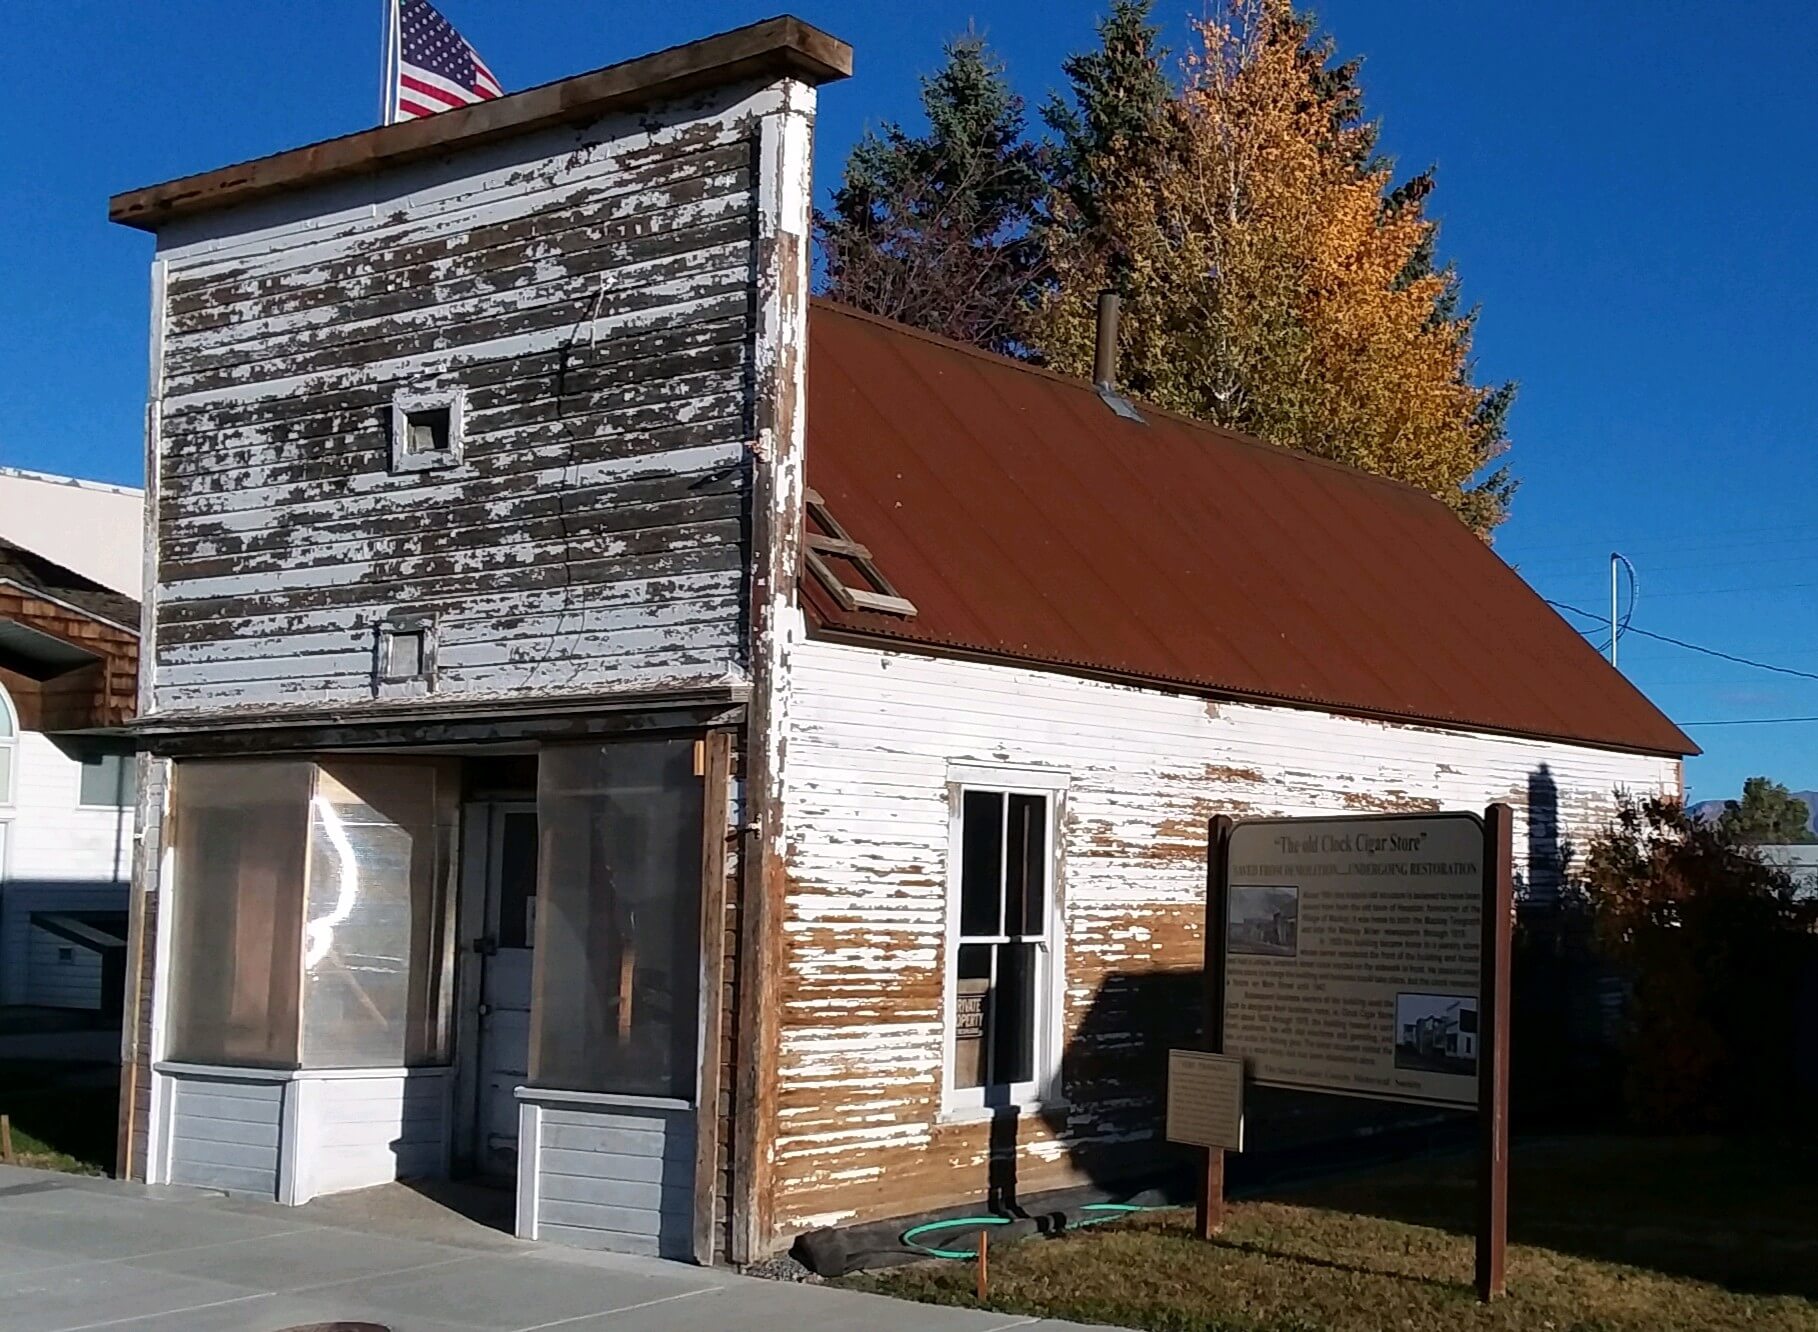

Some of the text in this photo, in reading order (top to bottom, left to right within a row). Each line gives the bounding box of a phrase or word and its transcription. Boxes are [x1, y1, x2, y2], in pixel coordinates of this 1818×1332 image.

[1302, 834, 1319, 853] old
[1321, 833, 1352, 852] Clock
[1356, 833, 1387, 855] Cigar
[1410, 862, 1477, 875] RESTORATION
